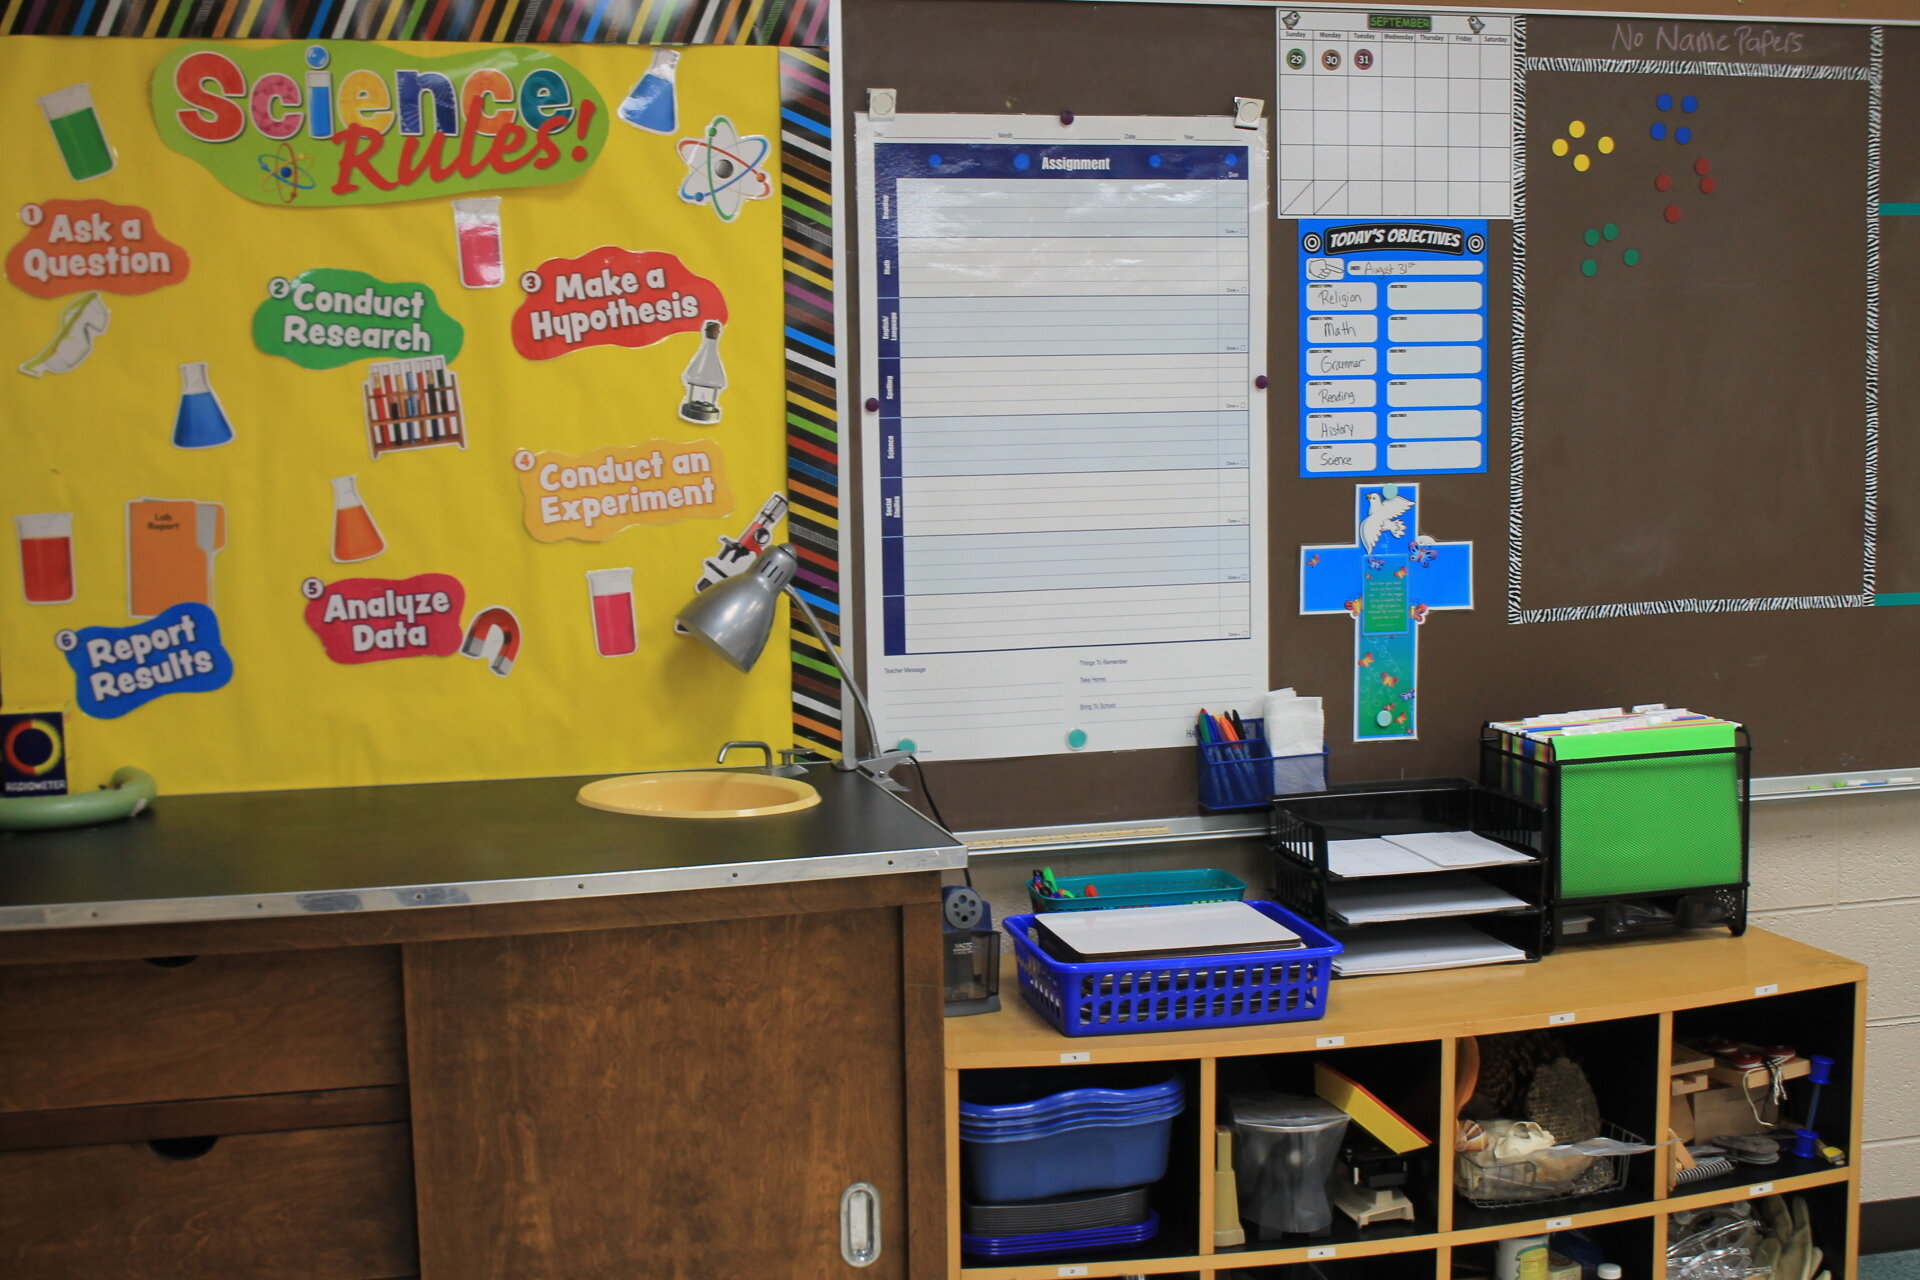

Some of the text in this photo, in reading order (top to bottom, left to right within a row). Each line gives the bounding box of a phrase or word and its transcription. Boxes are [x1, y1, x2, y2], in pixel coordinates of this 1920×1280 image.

[1370, 15, 1429, 28] SEPTEMBER
[1285, 31, 1508, 44] Sunday Monday Tuesday Wednesday Thursday Friday Saturday
[1611, 23, 1805, 57] No Name Papers
[1290, 55, 1370, 65] 29 30 31
[173, 44, 577, 143] Science
[330, 98, 597, 195] Rules!
[1041, 156, 1111, 171] Assignment
[48, 214, 142, 244] Ask a
[1330, 228, 1462, 248] TODAY'S OBJECTIVES
[23, 246, 171, 282] Question
[1364, 261, 1395, 280] August
[555, 267, 665, 303] Make a
[1318, 289, 1362, 308] Religion
[292, 283, 425, 320] Conduct
[282, 316, 431, 352] Research
[529, 294, 699, 344] Hypothesis
[1323, 321, 1357, 338] Math
[1320, 355, 1366, 374] Grammar
[1318, 388, 1356, 405] Reading
[1320, 422, 1354, 439] History
[887, 435, 895, 459] Science
[1320, 452, 1353, 467] Science
[539, 450, 710, 491] Conduct an
[540, 477, 715, 526] Experiment
[323, 590, 451, 623] Analyze
[86, 615, 197, 668] Report
[352, 622, 427, 653] Data
[89, 648, 214, 702] Results
